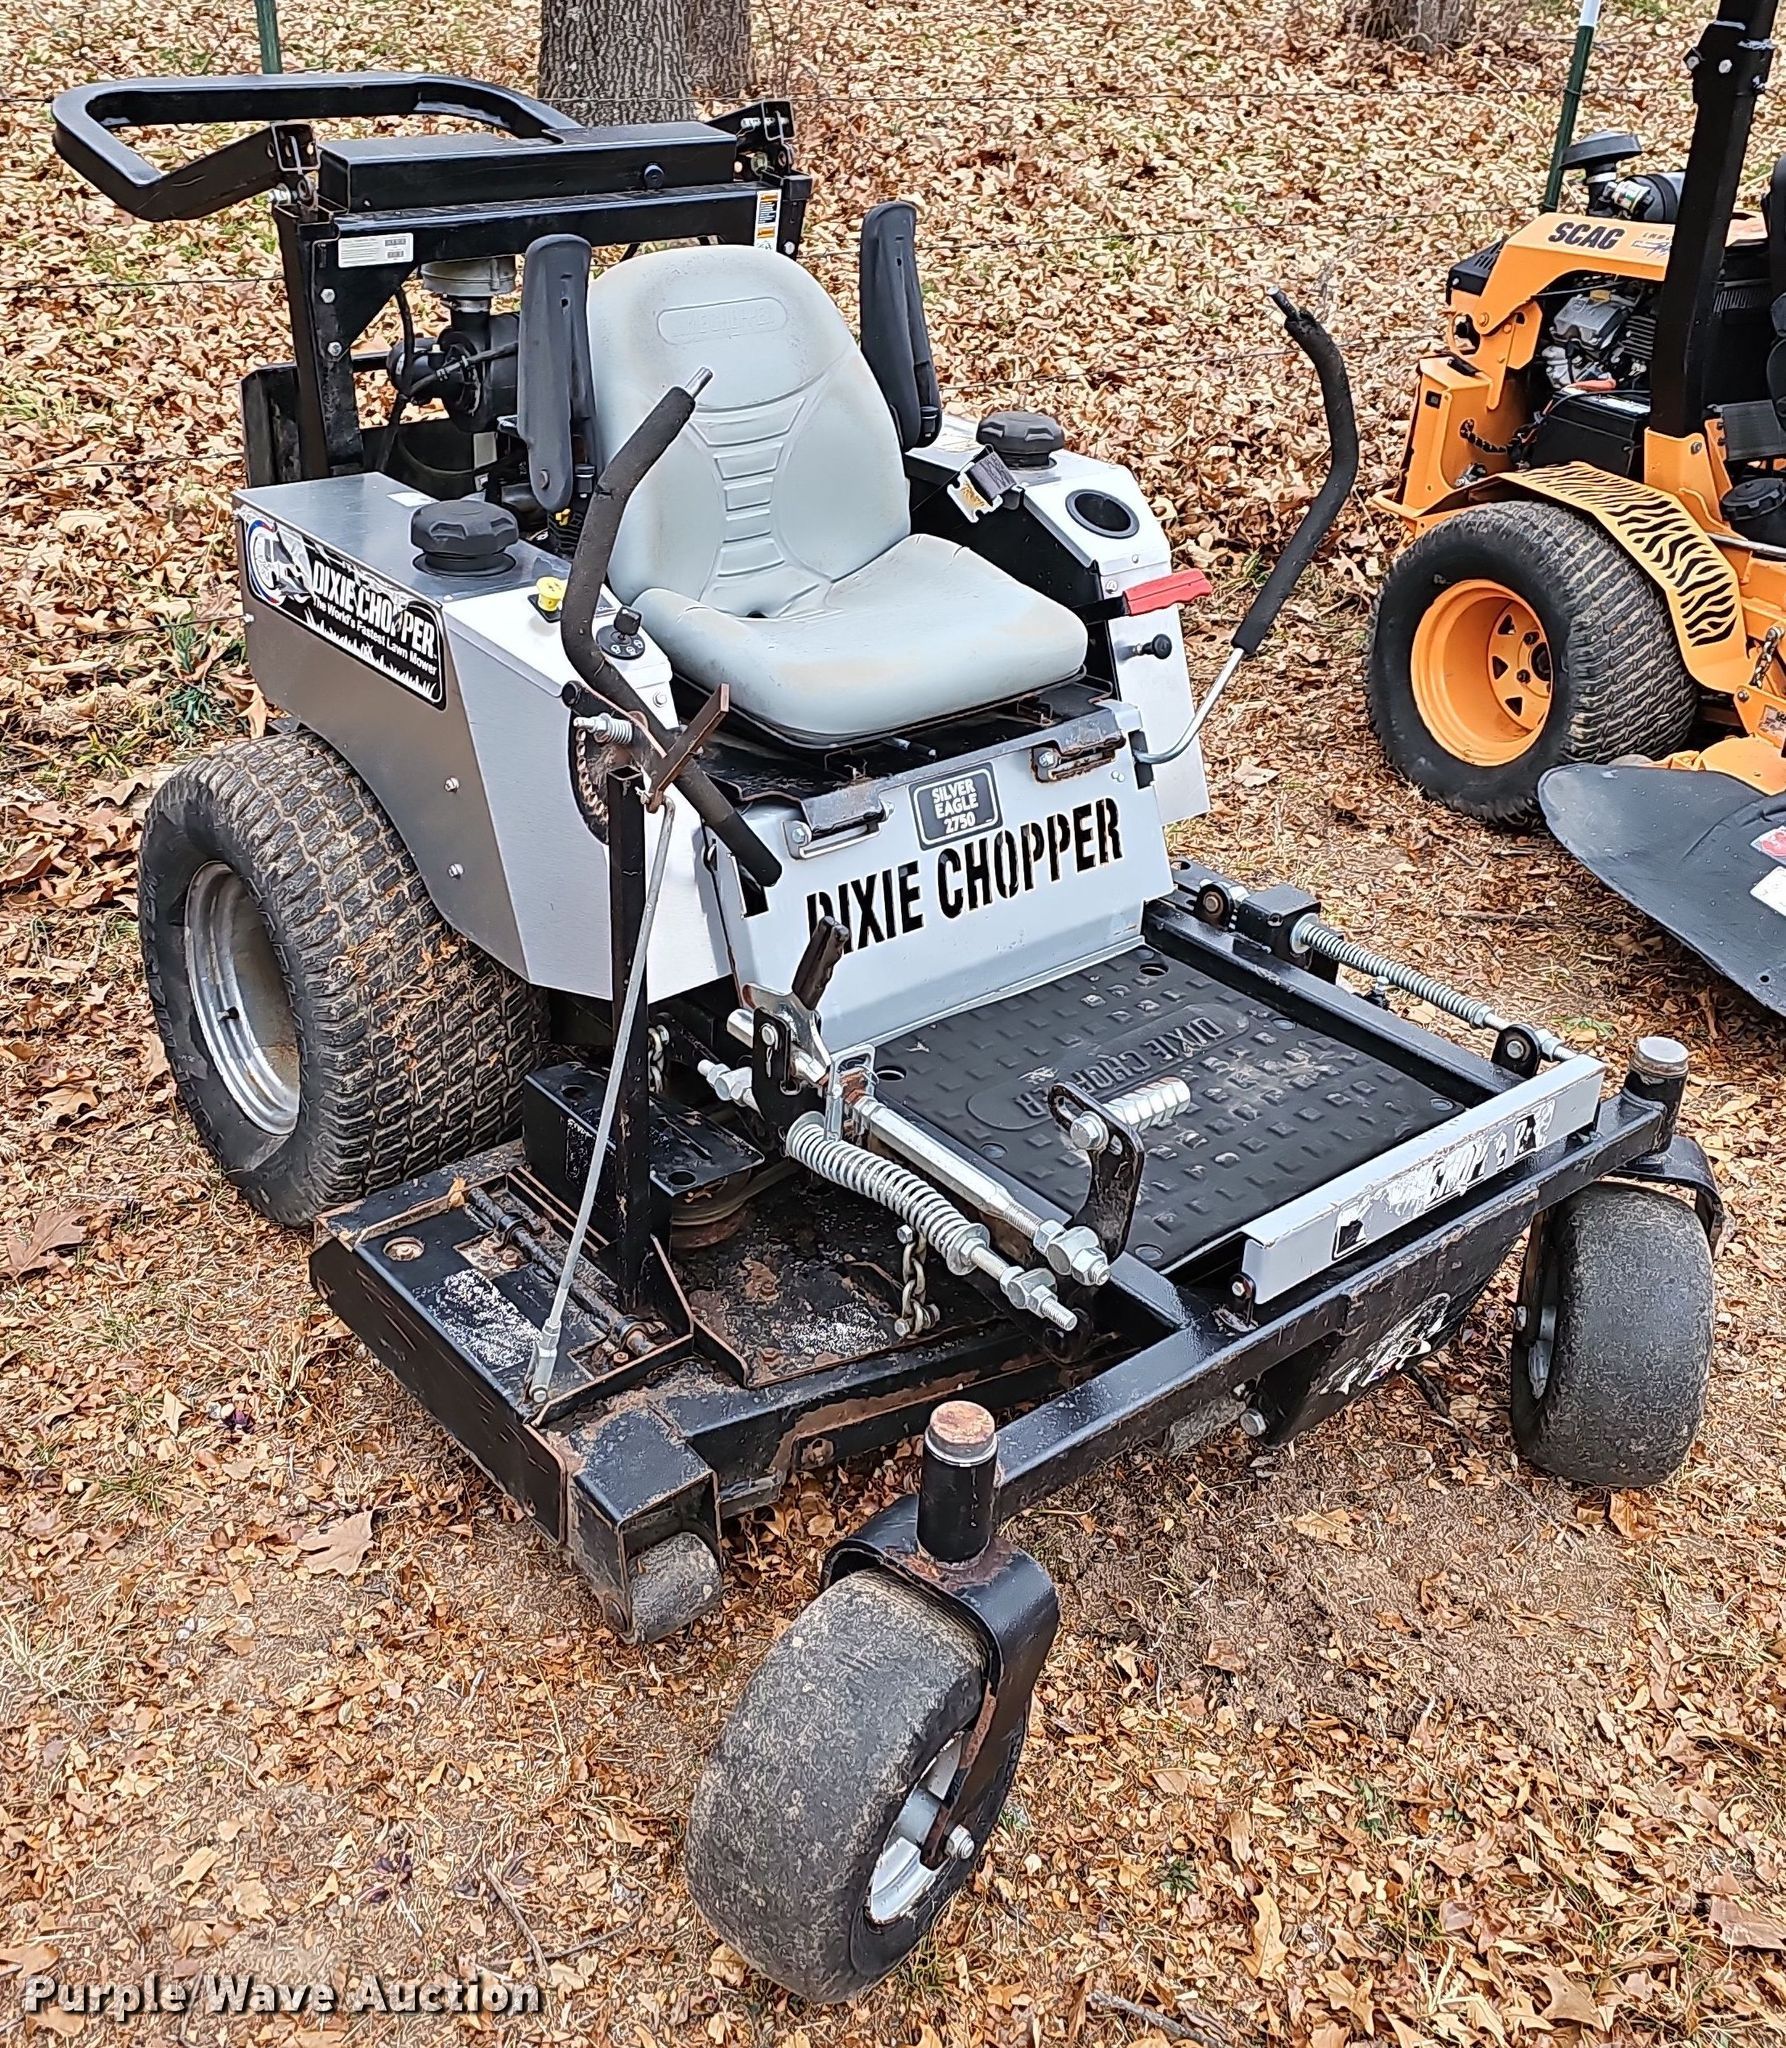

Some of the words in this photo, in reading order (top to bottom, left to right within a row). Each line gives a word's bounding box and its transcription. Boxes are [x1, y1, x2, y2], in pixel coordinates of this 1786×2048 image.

[1548, 221, 1626, 250] SCAG
[313, 560, 356, 613] DIXIE
[313, 594, 326, 612] The
[327, 602, 356, 630] World's
[356, 619, 386, 647] Fastest
[386, 636, 409, 660] Lawn
[409, 650, 438, 677] Mower
[931, 778, 976, 804] SILVER
[934, 793, 979, 819] EAGLE
[943, 811, 976, 835] 2750
[806, 860, 924, 954] DIXIE
[937, 798, 1123, 920] CHOPPER
[1144, 1017, 1225, 1061] DIXIE
[1014, 1050, 1152, 1117] CHOPR
